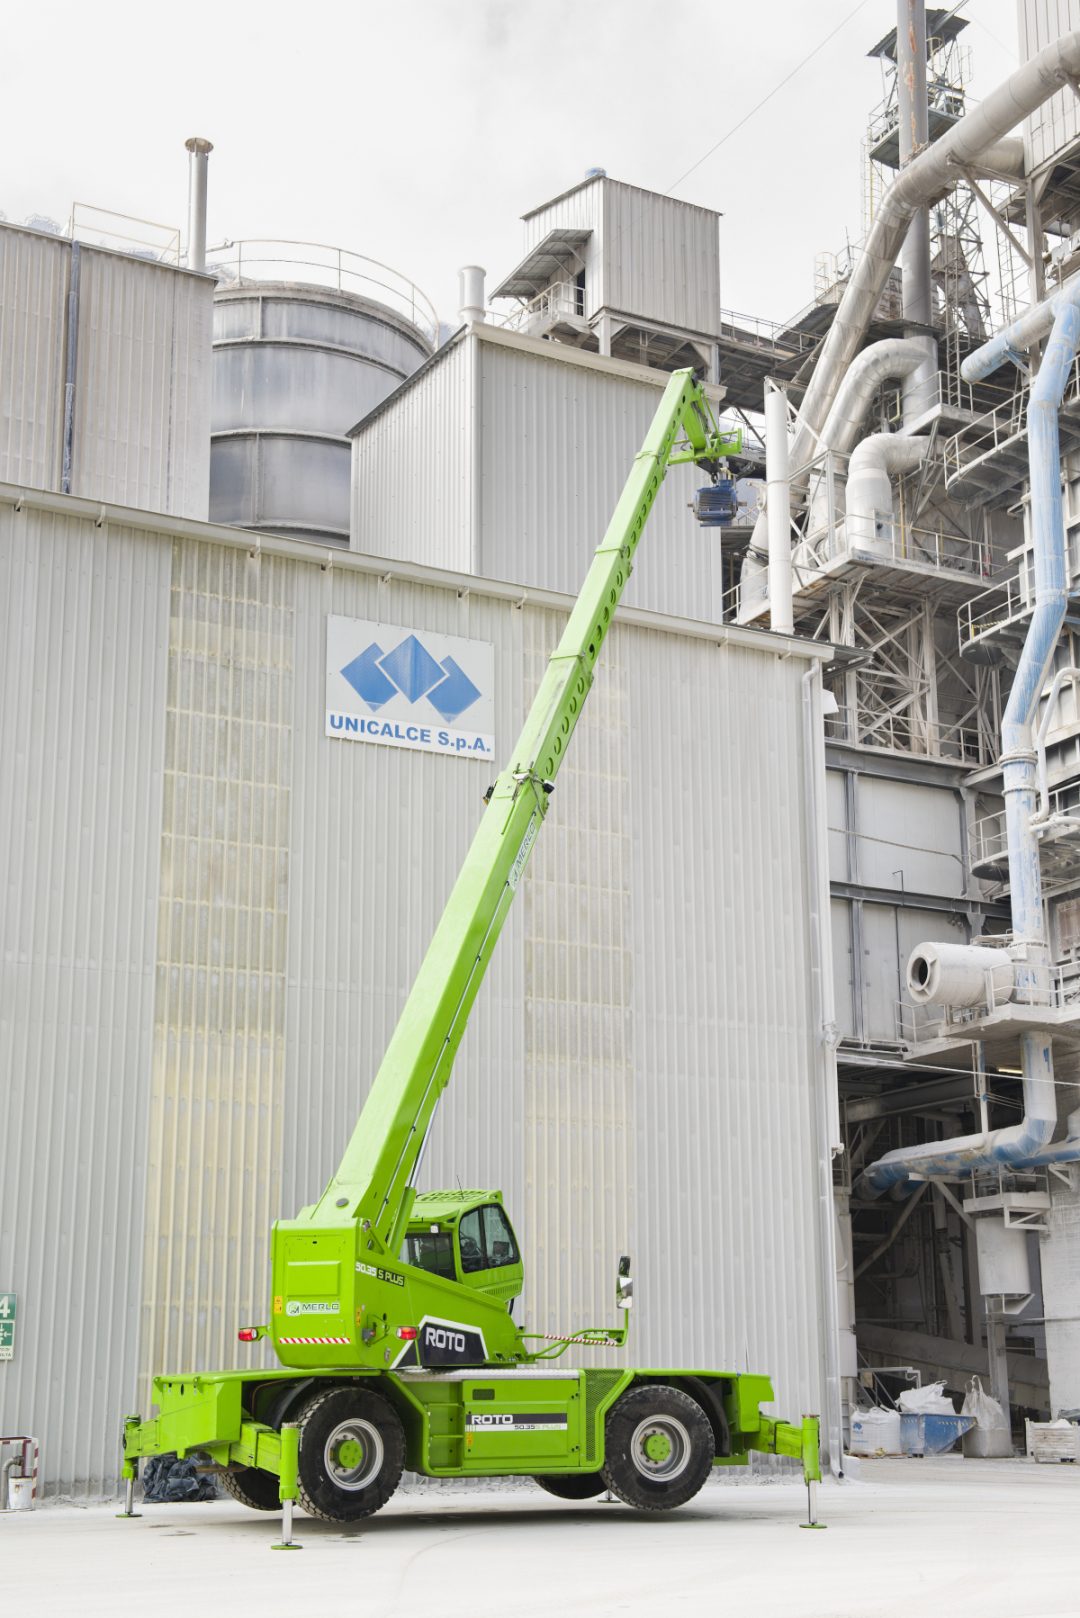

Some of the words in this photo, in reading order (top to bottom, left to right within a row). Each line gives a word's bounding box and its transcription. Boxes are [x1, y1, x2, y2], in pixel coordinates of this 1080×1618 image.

[330, 714, 431, 743] UNICALCE
[438, 731, 491, 753] S.p.A.
[516, 822, 536, 868] MERLO
[355, 1261, 377, 1278] 50.35
[378, 1269, 384, 1279] S
[385, 1271, 404, 1286] PLUS
[302, 1303, 340, 1311] MERLO
[425, 1327, 465, 1352] ROTO
[471, 1414, 513, 1424] ROTO
